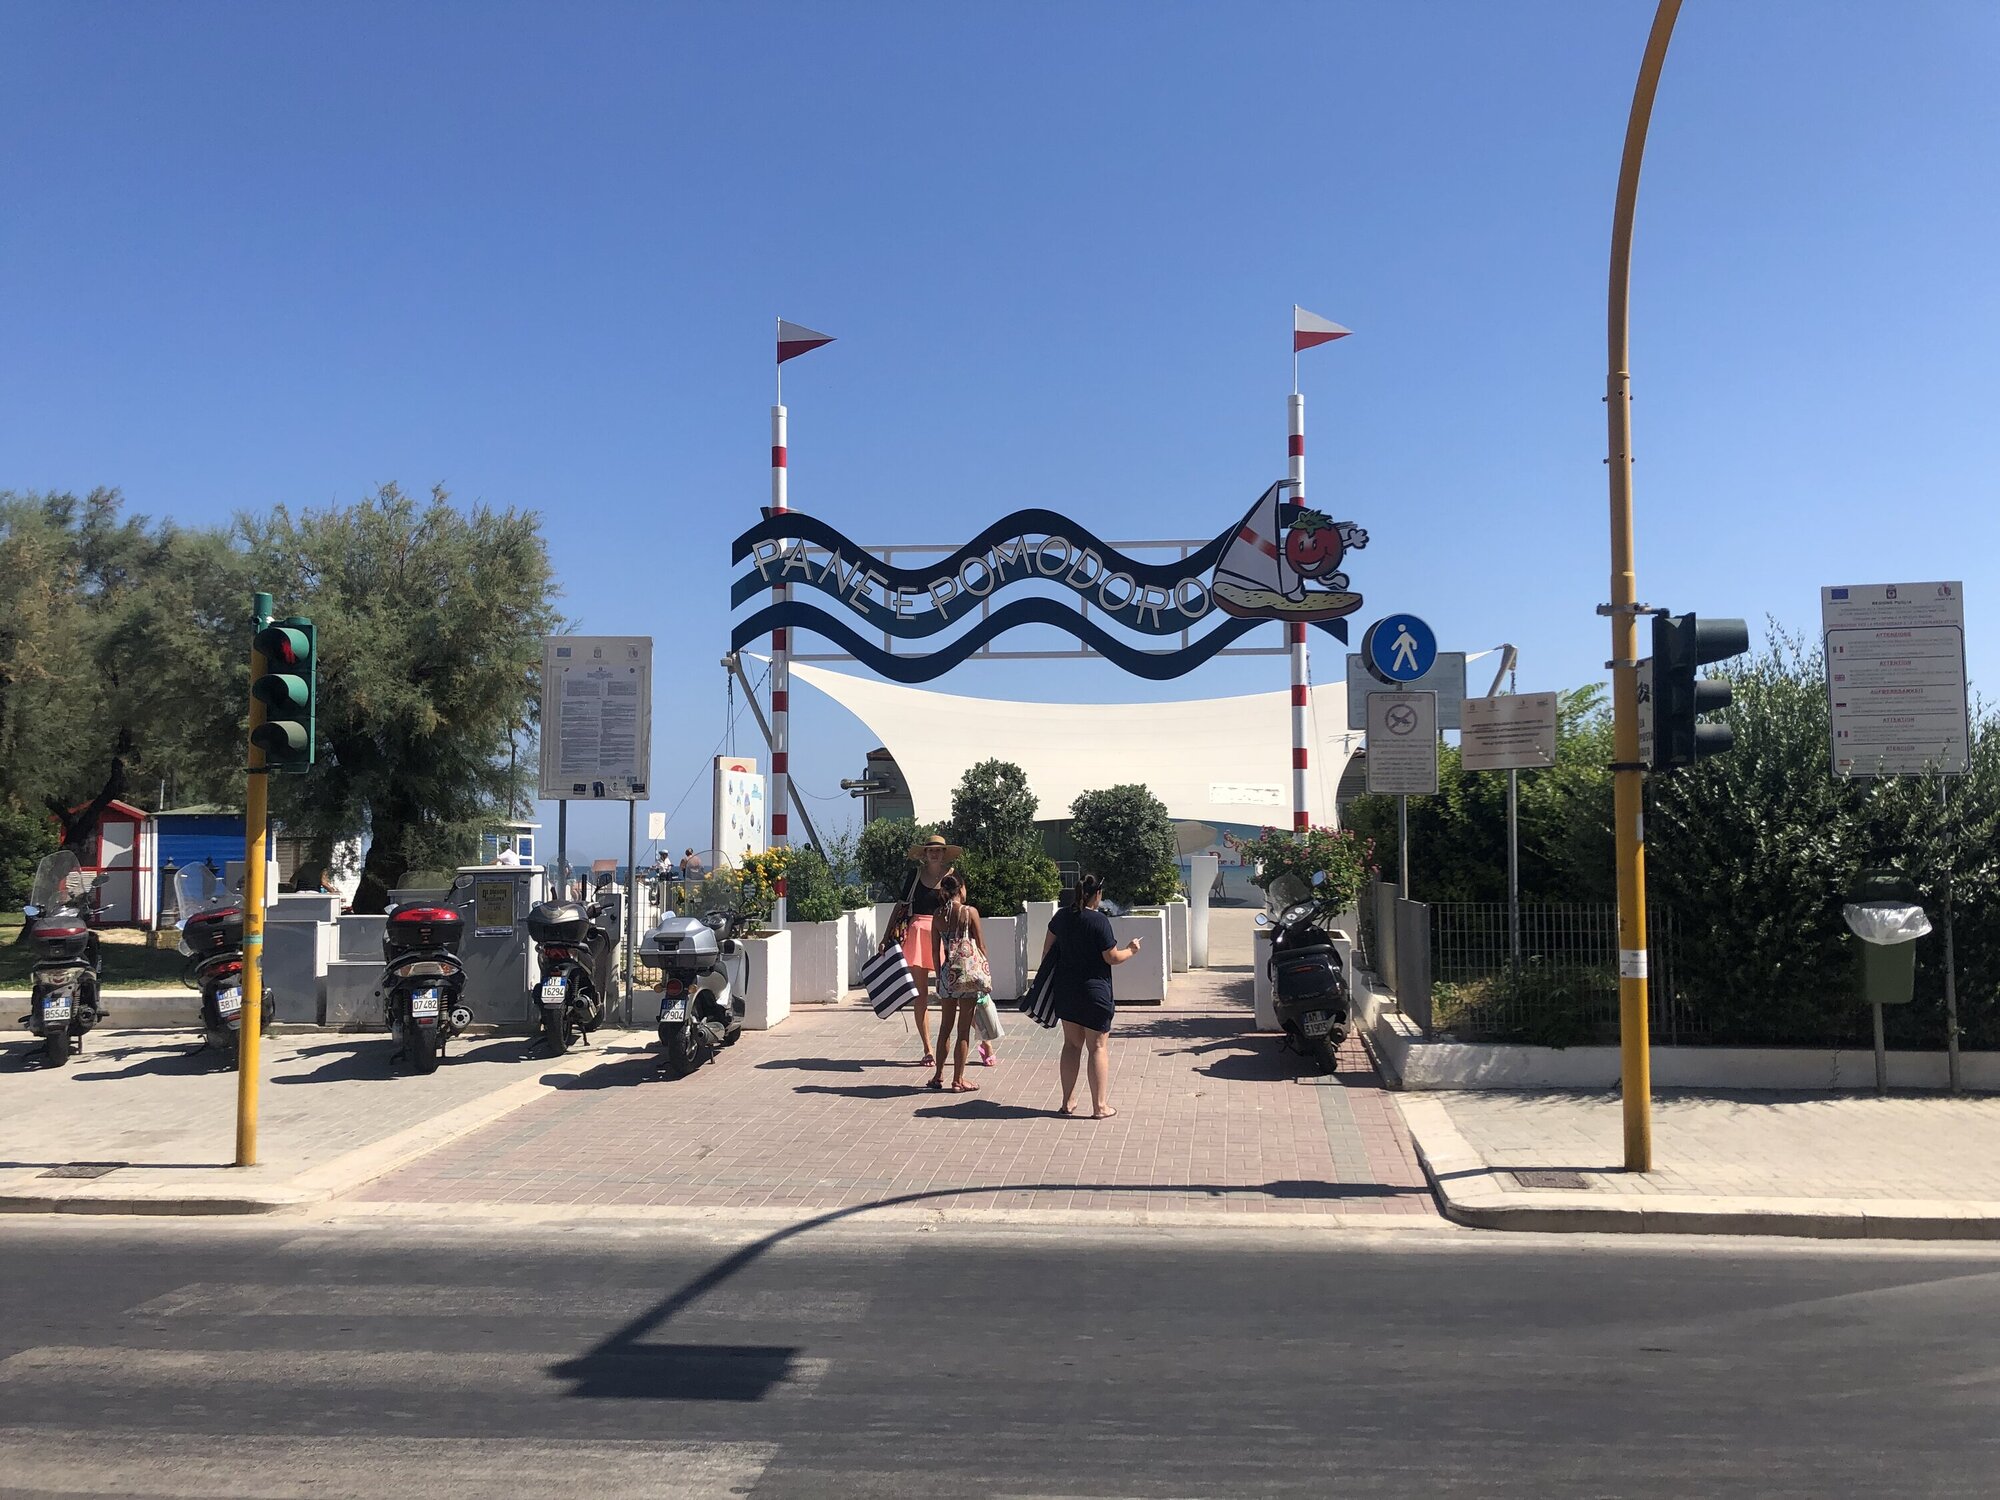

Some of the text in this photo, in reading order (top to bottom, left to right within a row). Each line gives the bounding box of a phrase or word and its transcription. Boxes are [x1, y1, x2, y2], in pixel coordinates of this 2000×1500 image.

[751, 534, 1209, 629] PANE E POMODORO
[543, 987, 564, 996] 16294
[413, 1000, 437, 1010] 07482
